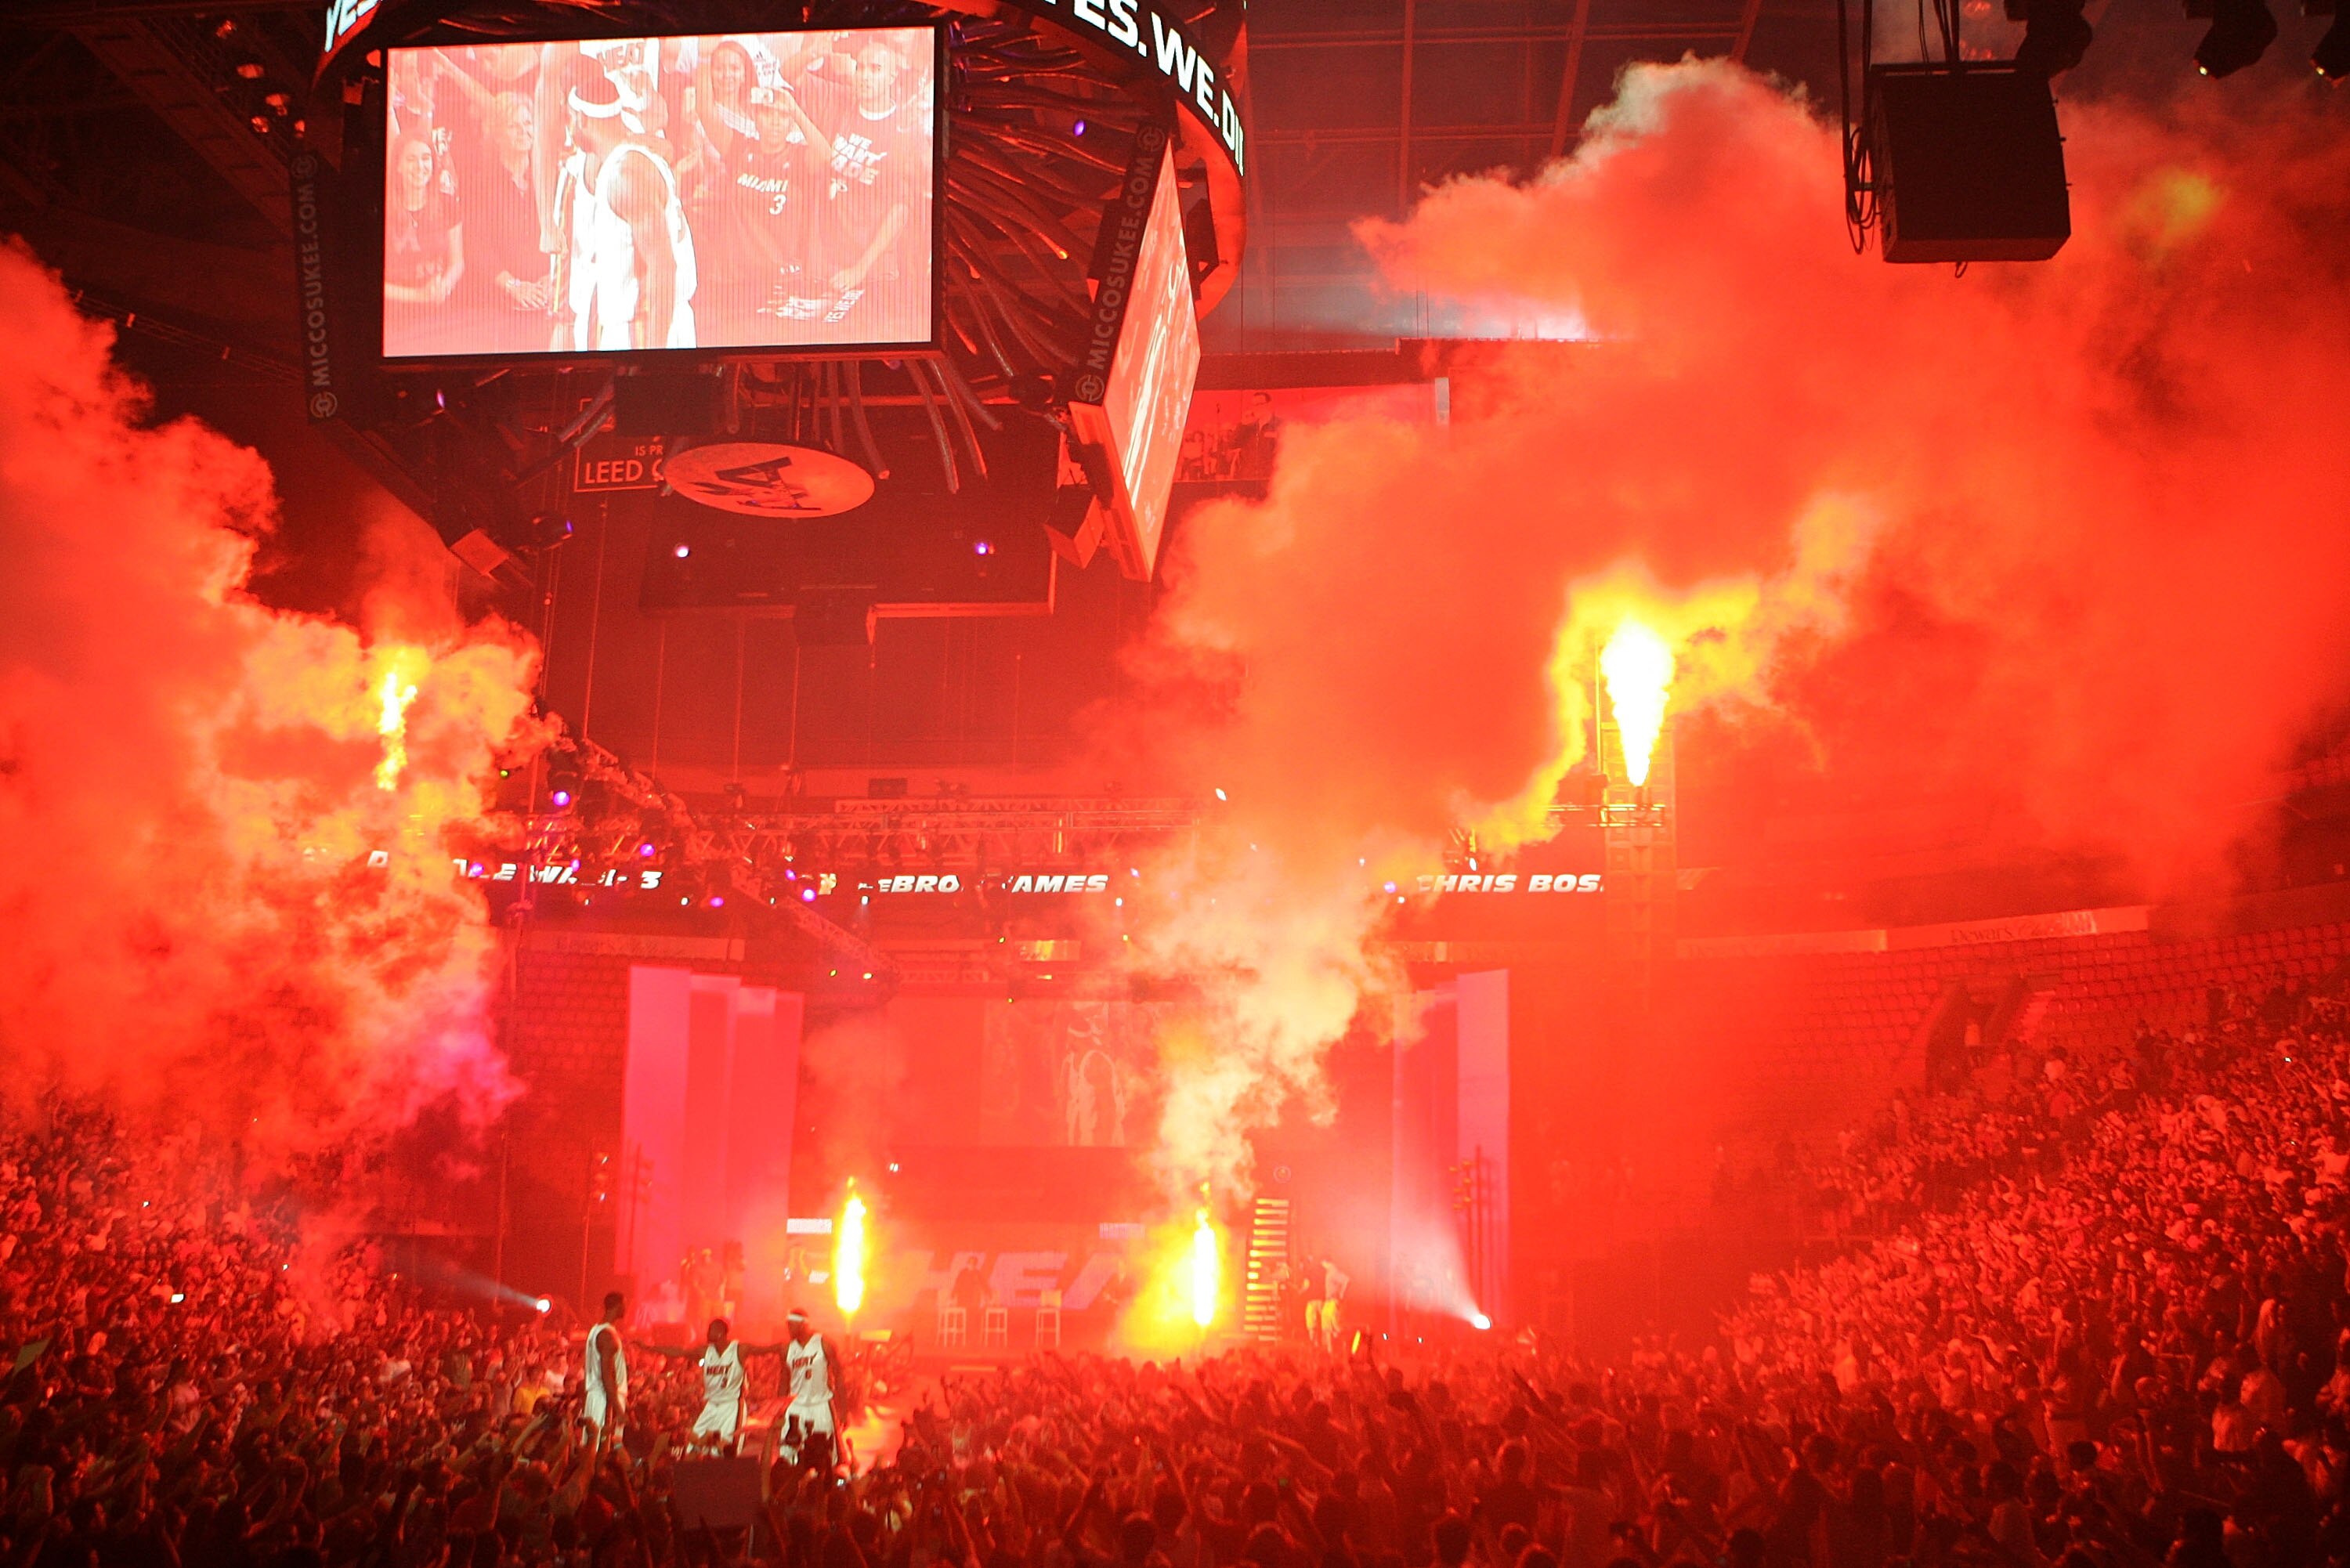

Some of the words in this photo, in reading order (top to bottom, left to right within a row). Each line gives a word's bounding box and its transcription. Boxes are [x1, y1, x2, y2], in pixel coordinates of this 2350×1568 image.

[596, 42, 645, 72] HEAT
[737, 172, 789, 193] MIAMI
[769, 194, 787, 215] 3
[1086, 157, 1155, 370] MICCOSUKEE.COM
[298, 182, 331, 387] MICCOSUKEE.COM
[635, 446, 645, 457] IS
[585, 459, 643, 483] LEED
[640, 871, 662, 889] 3
[1002, 875, 1108, 893] AMES
[1528, 875, 1604, 892] BOS
[707, 1361, 734, 1375] HEAT
